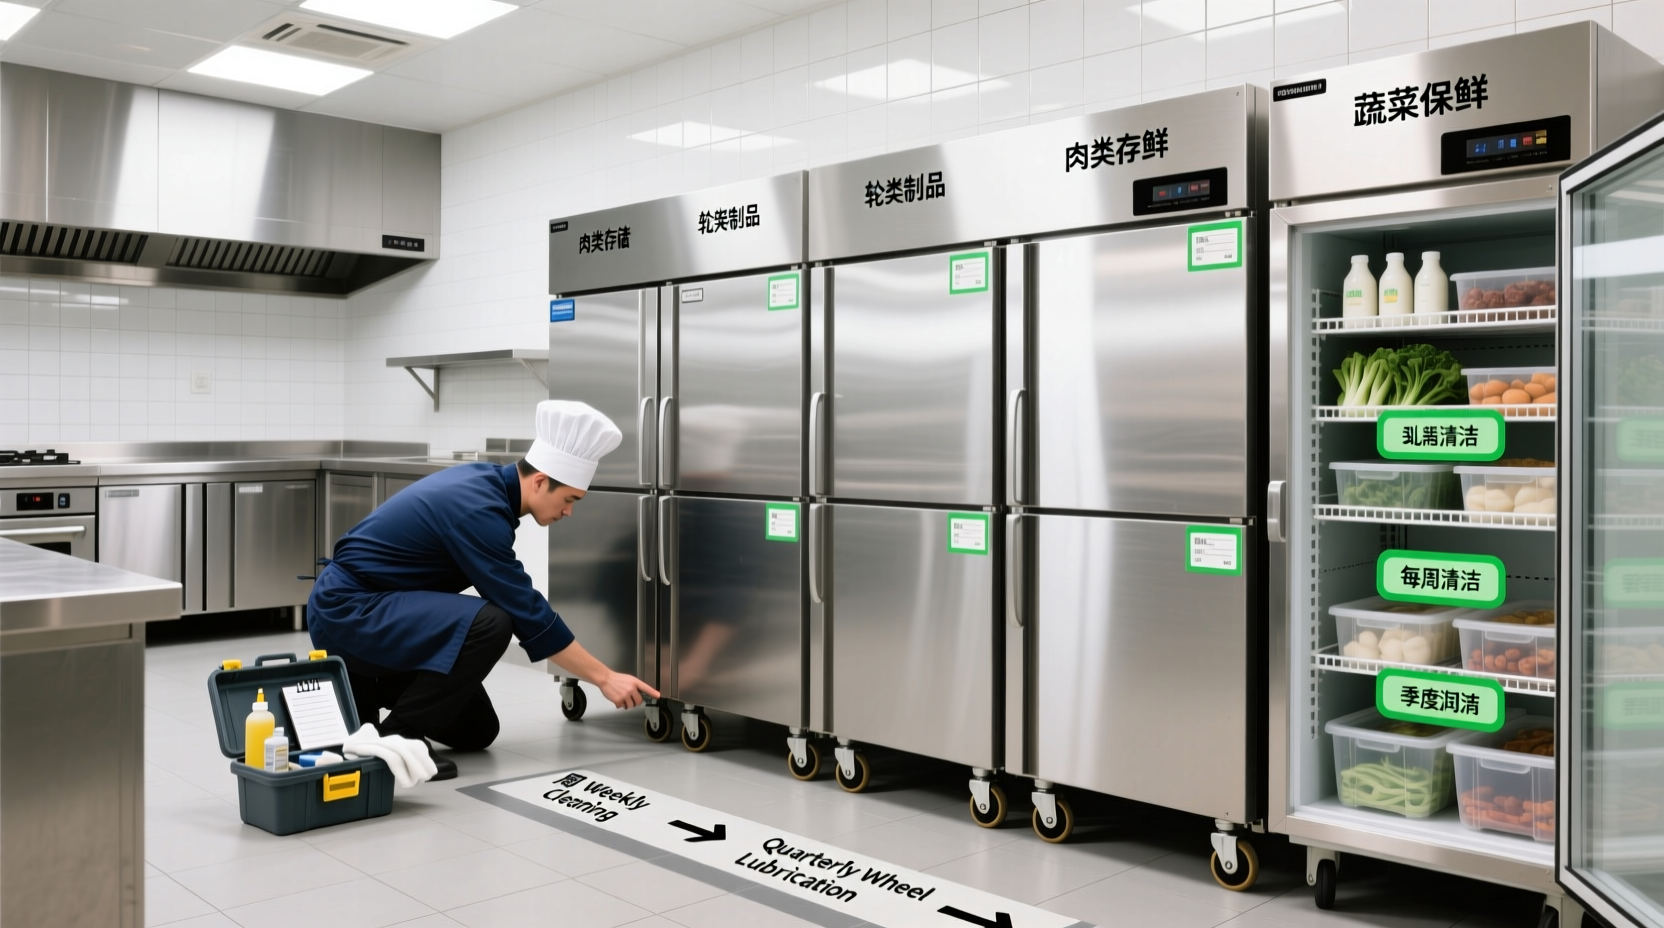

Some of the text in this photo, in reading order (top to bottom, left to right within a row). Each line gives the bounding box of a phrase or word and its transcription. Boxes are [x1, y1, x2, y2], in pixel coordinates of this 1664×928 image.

[1353, 73, 1489, 127] 蔬菜保鲜
[1065, 127, 1169, 173] 肉类存鲜
[1400, 564, 1482, 592] 每周清洁
[543, 788, 619, 823] Cleaning
[583, 780, 651, 811] Weekly
[734, 852, 858, 902] Lubrication
[762, 837, 936, 902] Quarterly Wheel
